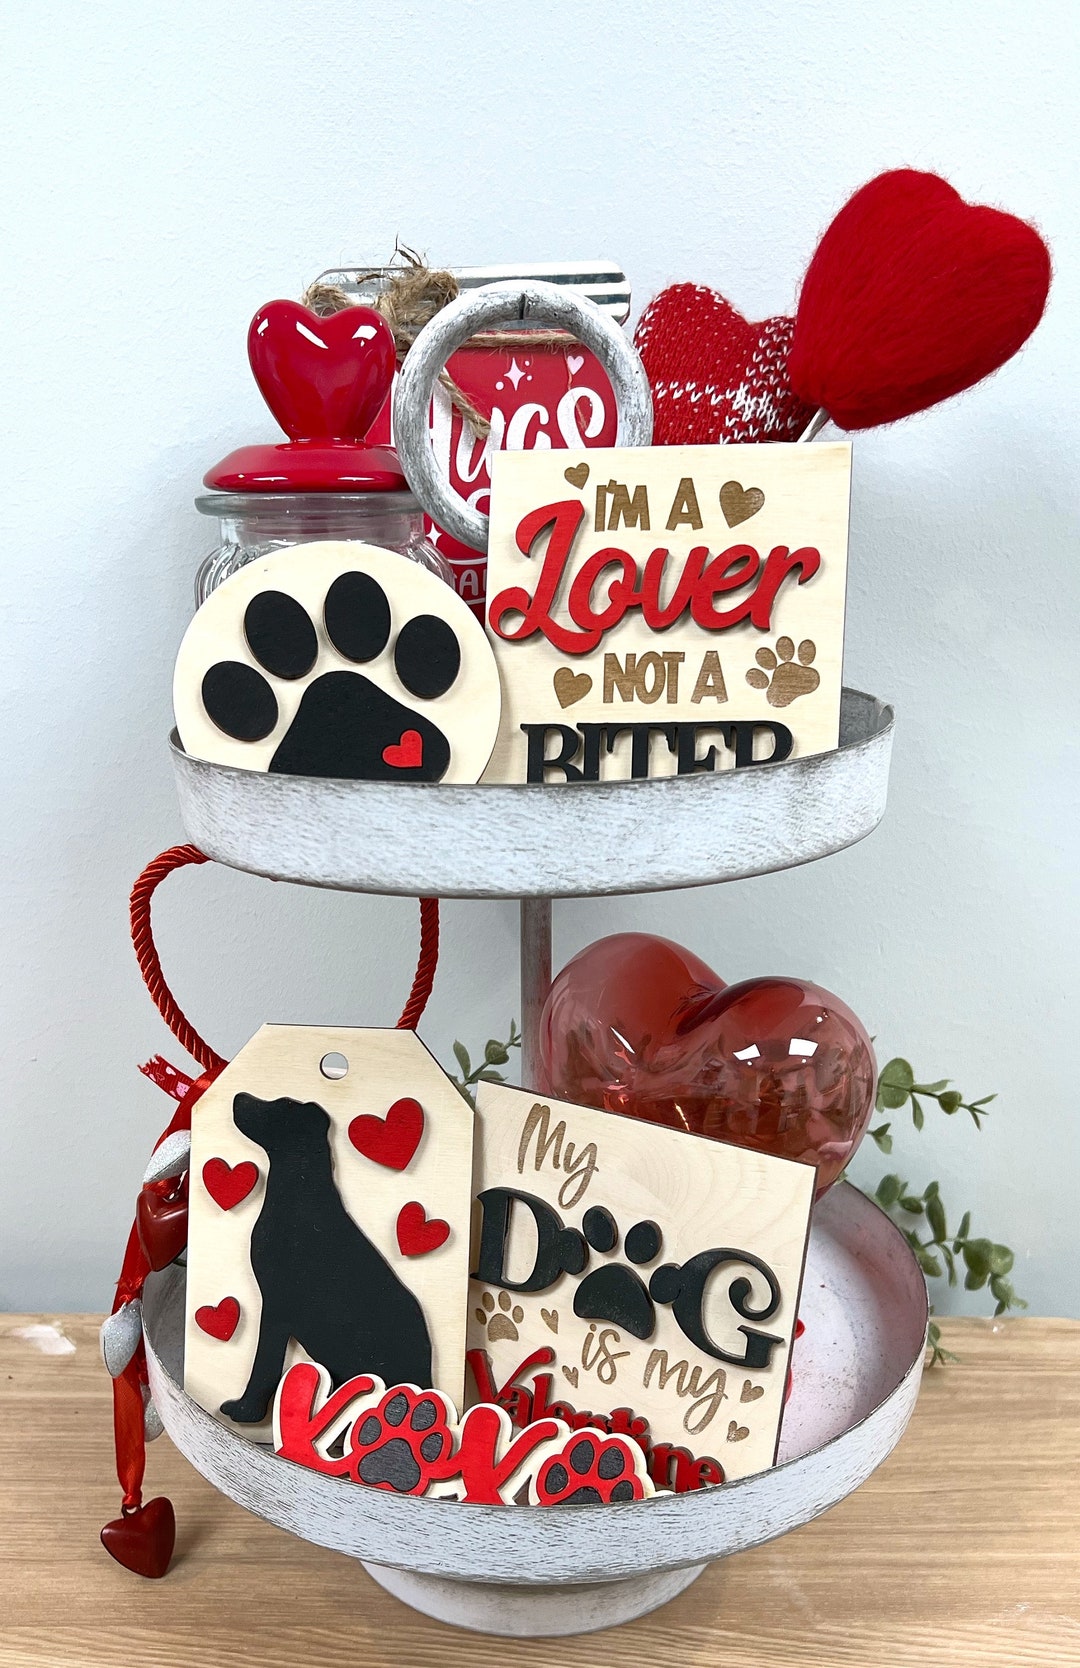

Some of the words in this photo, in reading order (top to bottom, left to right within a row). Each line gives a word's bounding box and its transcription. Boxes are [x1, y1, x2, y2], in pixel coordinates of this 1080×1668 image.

[594, 478, 651, 532] I'M
[665, 477, 704, 531] A
[488, 499, 822, 655] Lover
[602, 650, 686, 704] NOT
[690, 650, 729, 704] A
[516, 1102, 600, 1211] My
[581, 1323, 630, 1385] is
[642, 1348, 729, 1435] my
